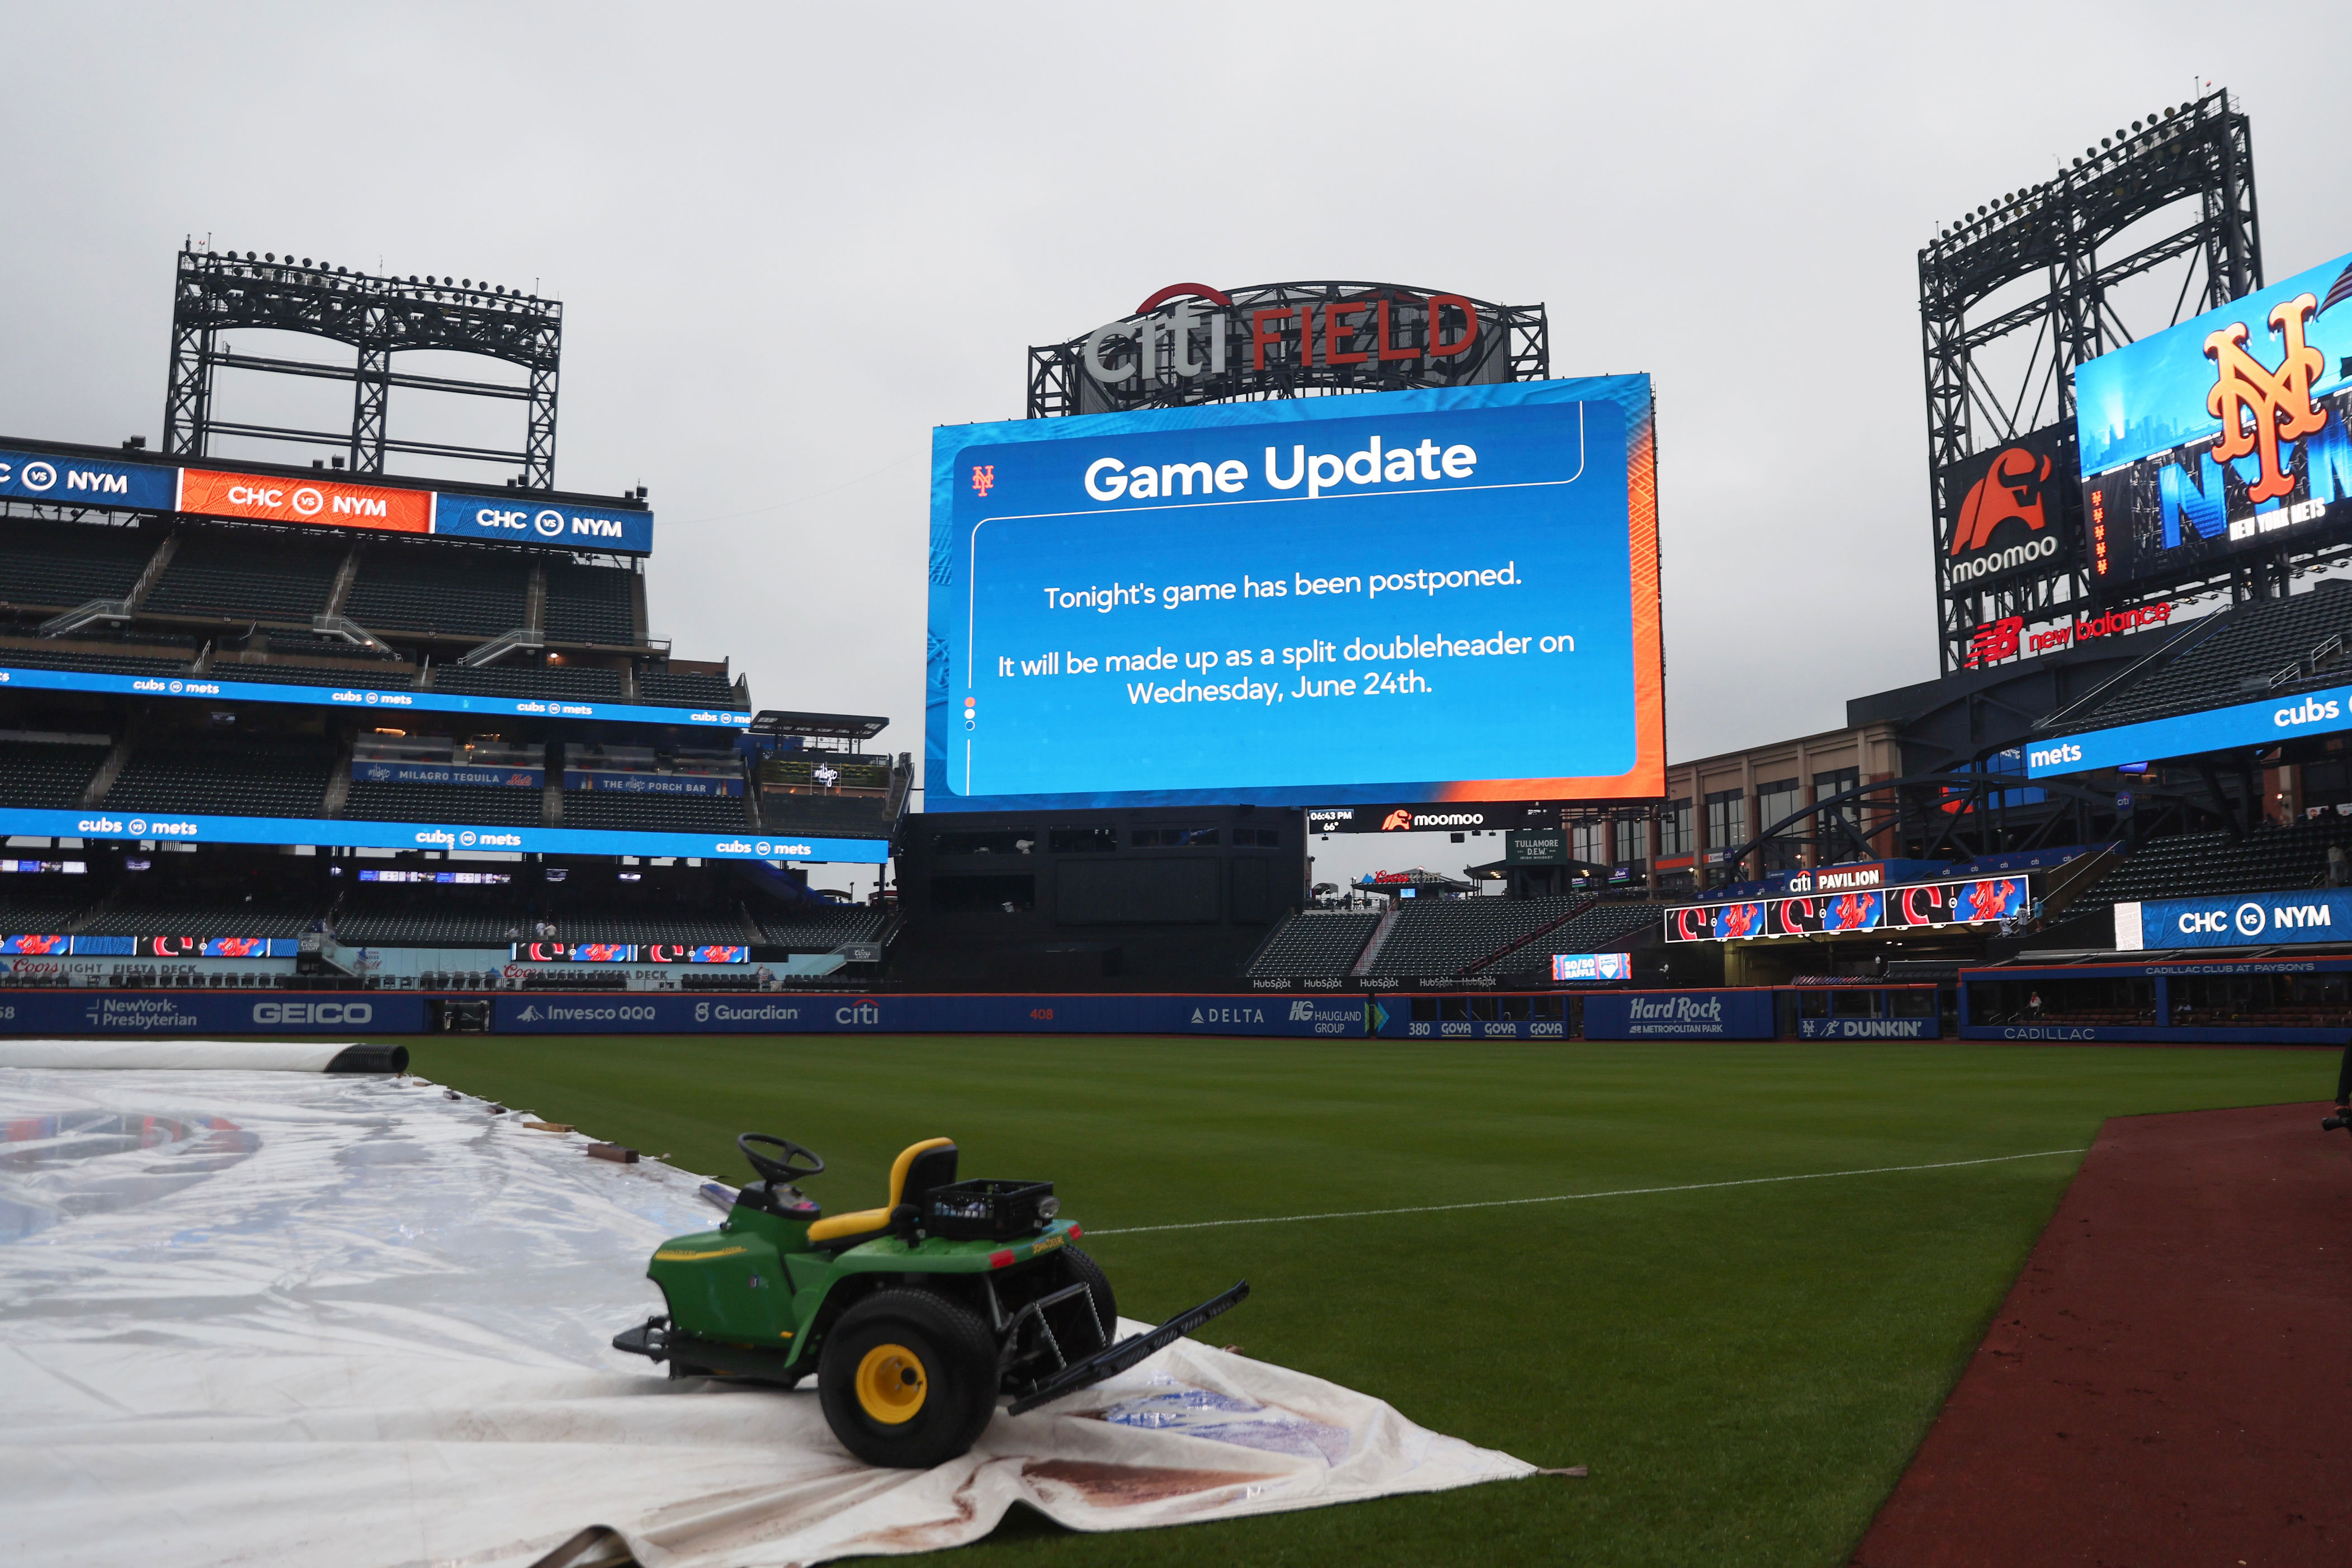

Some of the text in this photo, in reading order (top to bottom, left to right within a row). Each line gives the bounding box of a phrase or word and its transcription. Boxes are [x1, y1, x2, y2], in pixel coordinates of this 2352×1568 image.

[1084, 295, 1478, 383] citi FIELD
[1084, 436, 1477, 501] Game Update
[67, 470, 128, 494] NYM
[228, 486, 283, 508] CHC
[333, 495, 387, 517] NYM
[476, 508, 527, 530] CHC
[572, 517, 622, 538] NYM
[2230, 497, 2326, 542] NEW YORK METS
[1952, 536, 2058, 584] moomoo
[1045, 561, 1522, 615] Tonight's game has been postponed.
[2029, 602, 2171, 653] new balance
[998, 631, 1575, 678] It will be made up as a split doubleheader on
[133, 678, 166, 692] cubs
[186, 683, 220, 694] mets
[1126, 667, 1433, 706] Wednesday, June 24th.
[332, 690, 362, 702] cubs
[380, 695, 413, 705] mets
[516, 702, 546, 713] cubs
[563, 706, 593, 715] mets
[2274, 696, 2340, 727] cubs
[690, 712, 718, 722] cubs
[2030, 742, 2082, 768] mets
[399, 770, 449, 781] MILAGRO
[454, 772, 499, 783] TEQUILA
[507, 773, 532, 786] Mets
[604, 780, 623, 788] THE
[649, 782, 682, 791] PORCH
[686, 784, 706, 792] BAR
[1310, 811, 1353, 821] 06:43 PM
[1414, 813, 1484, 826] moomoo
[78, 817, 123, 833] cubs
[152, 821, 197, 835] mets
[415, 829, 455, 844] cubs
[479, 833, 522, 846] mets
[1515, 839, 1559, 848] TULLAMORE
[715, 840, 752, 853] cubs
[774, 844, 812, 855] mets
[1375, 870, 1410, 883] Coors
[1789, 870, 1879, 893] citi PAVILION
[2179, 910, 2228, 933] CHC
[2274, 905, 2331, 928] NYM
[13, 958, 59, 973] Coors
[113, 965, 155, 975] FIESTA
[161, 965, 197, 975] DECK
[1564, 958, 1595, 971] 50/50
[2146, 966, 2201, 975] CADILLAC
[2202, 965, 2233, 974] CLUB
[2254, 963, 2315, 972] PAYSON'S
[636, 970, 669, 979] DECK
[1565, 967, 1596, 979] RAFFLE
[1253, 979, 1291, 989] HubSpot
[1304, 978, 1343, 989] HubSpot
[1360, 977, 1399, 988] HubSpot
[1420, 977, 1453, 987] HubSpot
[1462, 976, 1496, 986] HubSpot
[104, 999, 177, 1012] NewYork-
[715, 1005, 799, 1019] Guardian
[836, 999, 880, 1024] citi
[1630, 996, 1722, 1022] Hard Rock
[253, 1003, 372, 1024] GEICO
[548, 1005, 656, 1021] Invesco QQQ
[1029, 1009, 1054, 1020] 408
[1208, 1009, 1264, 1023] DELTA
[1315, 1011, 1362, 1022] HAUGLAND
[103, 1013, 197, 1030] Presbyterian
[1315, 1023, 1345, 1033] GROUP
[1441, 1023, 1472, 1034] GOYA
[1484, 1023, 1517, 1034] GOYA
[1529, 1023, 1564, 1034] GOYA
[1643, 1024, 1723, 1033] METROPOLITAN PARK
[1409, 1023, 1430, 1036] 380
[1844, 1021, 1923, 1037] DUNKIN'
[2004, 1028, 2095, 1040] CADILLAC
